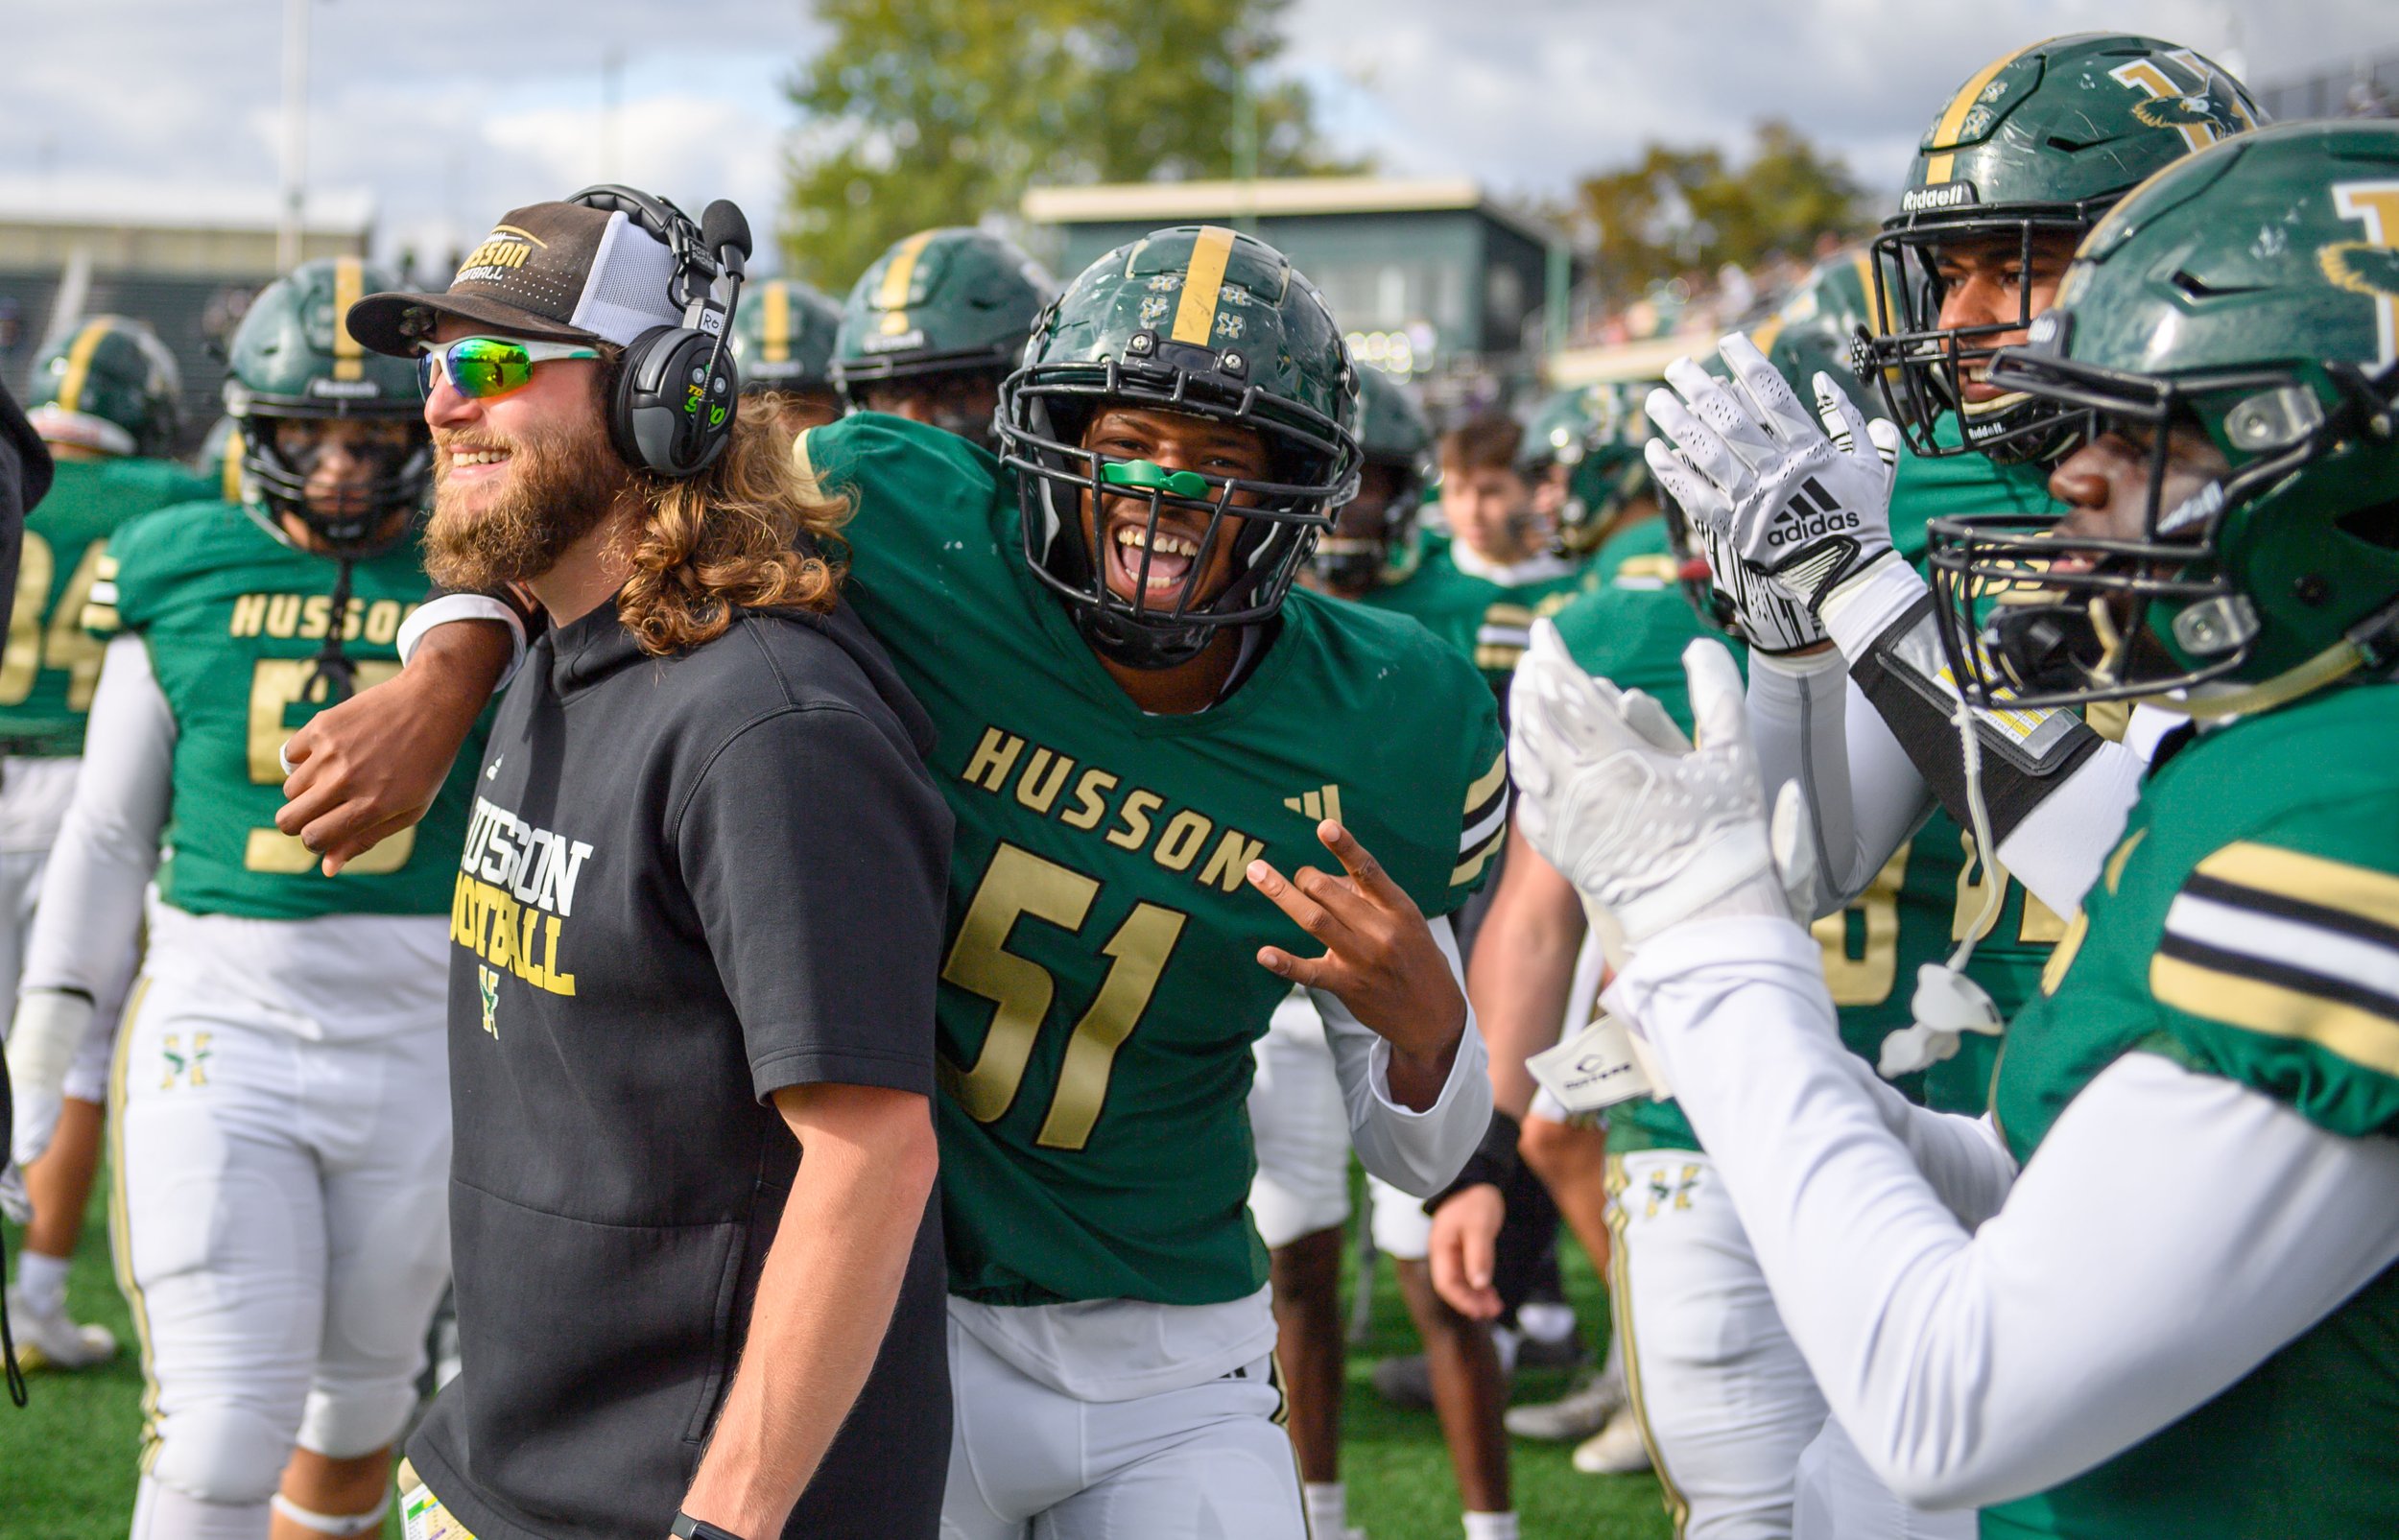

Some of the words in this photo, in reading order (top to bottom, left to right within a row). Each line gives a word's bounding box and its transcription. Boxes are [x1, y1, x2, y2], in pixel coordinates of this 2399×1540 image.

[1903, 184, 1963, 211] Riddell
[1767, 511, 1860, 547] adidas
[229, 593, 418, 646] HUSSO
[961, 725, 1267, 894] HUSSON
[460, 794, 595, 917] USSON
[935, 841, 1189, 1151] 51
